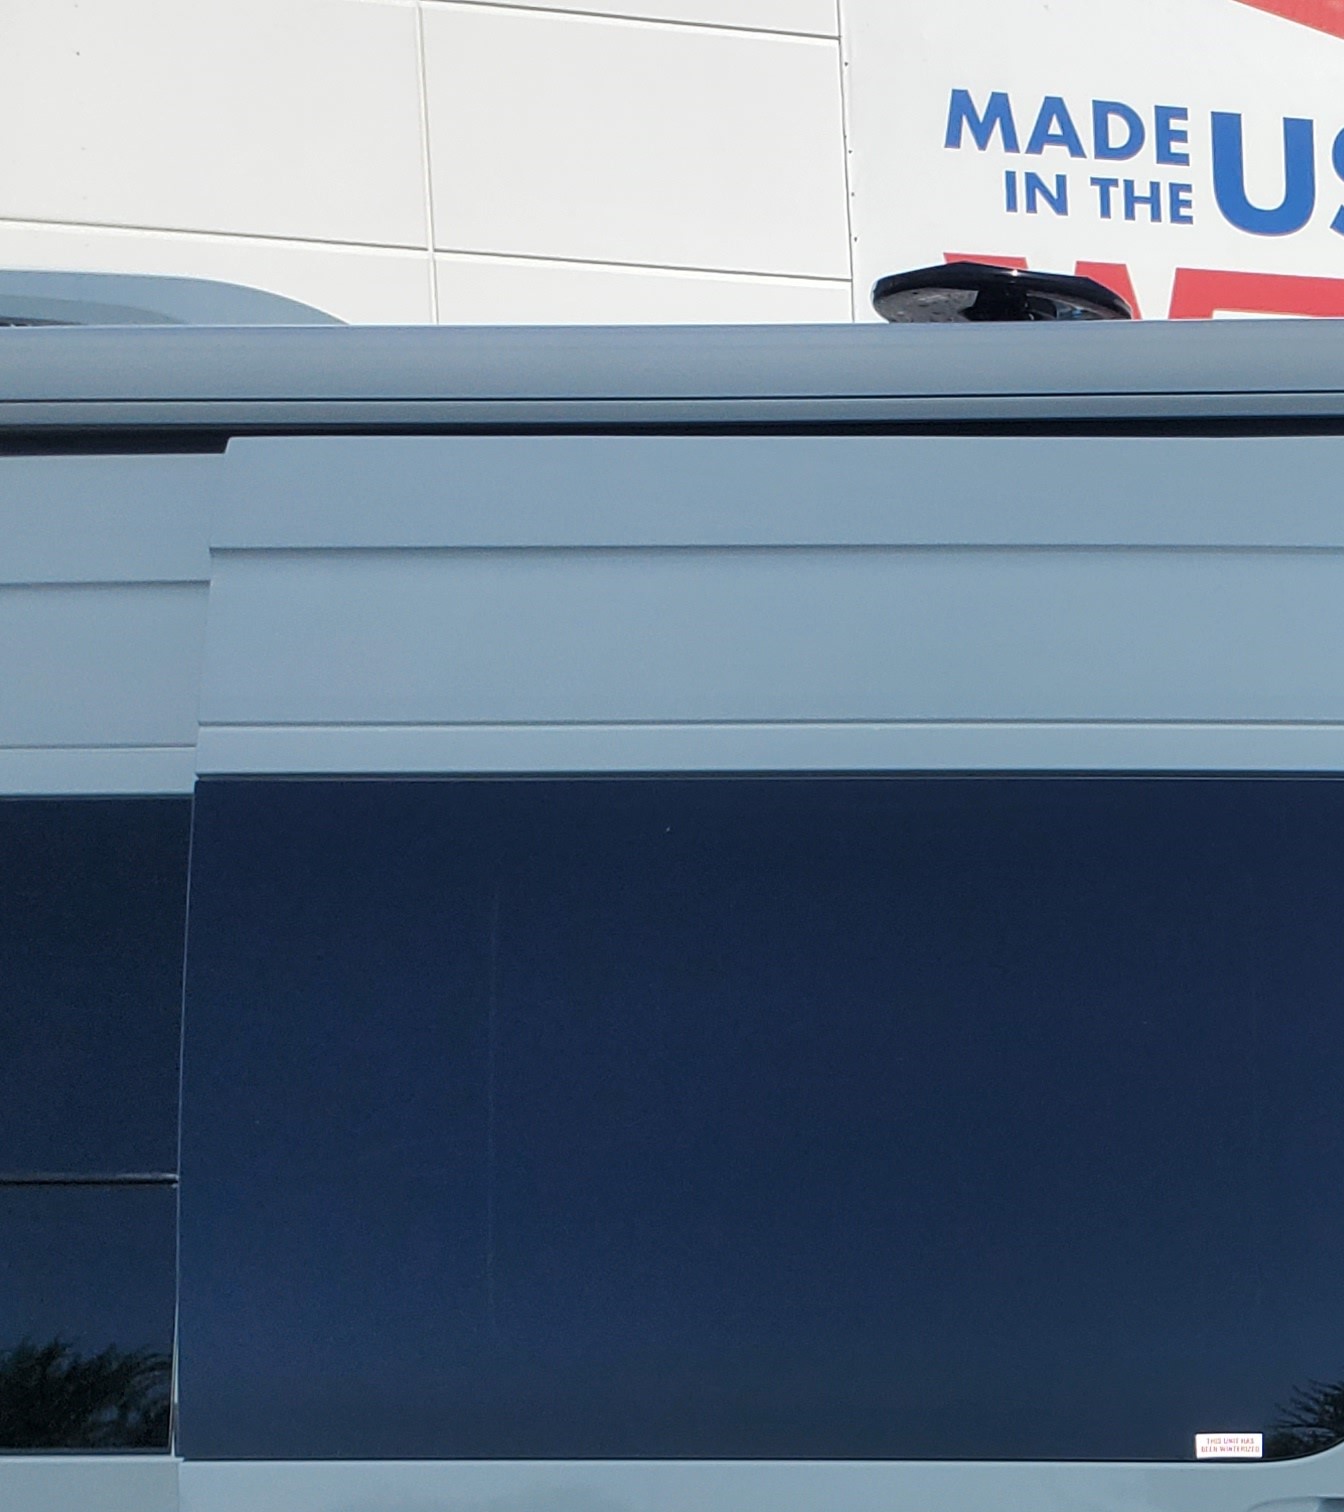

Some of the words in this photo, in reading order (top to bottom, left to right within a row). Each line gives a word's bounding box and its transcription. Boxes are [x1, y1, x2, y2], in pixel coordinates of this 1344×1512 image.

[944, 88, 1190, 165] MADE
[1004, 170, 1068, 215] IN
[1091, 177, 1193, 224] THE
